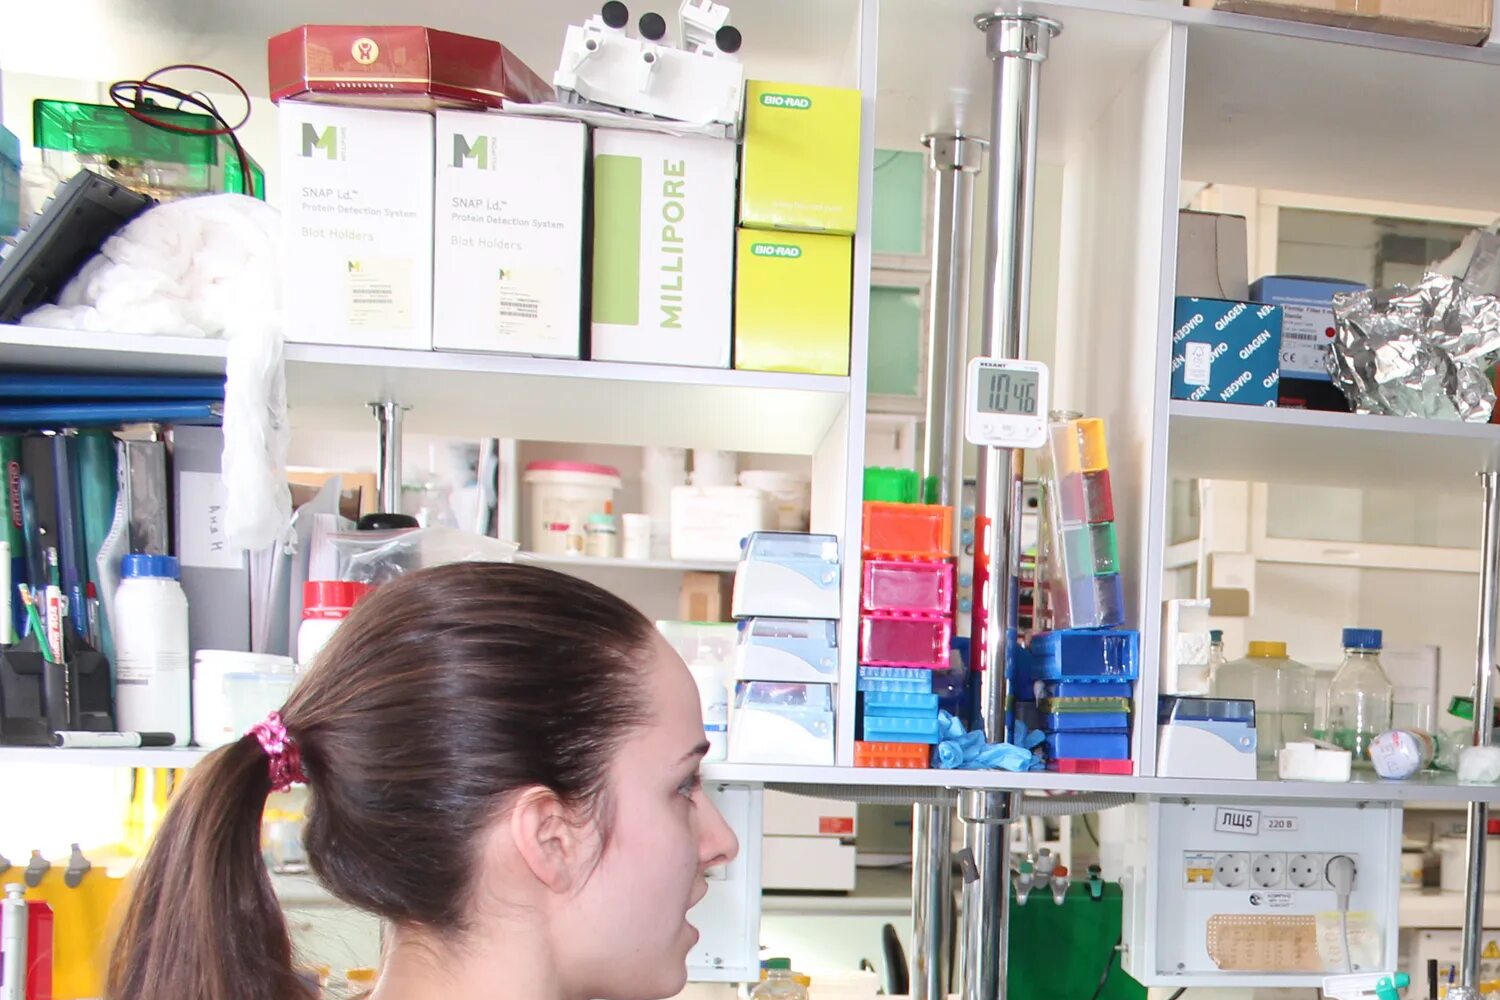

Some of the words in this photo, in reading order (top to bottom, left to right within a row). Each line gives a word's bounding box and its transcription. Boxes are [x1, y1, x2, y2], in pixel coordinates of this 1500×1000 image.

[302, 122, 338, 160] M
[452, 132, 488, 170] M
[302, 186, 334, 199] SNAP
[302, 202, 334, 212] Protein
[338, 204, 382, 216] Detection
[384, 208, 417, 219] System
[452, 196, 482, 209] SNAP
[451, 212, 484, 224] Protein
[486, 215, 530, 227] Detection
[532, 219, 564, 230] System
[302, 226, 325, 238] Blot
[329, 228, 375, 242] Holders
[450, 235, 474, 248] Blot
[478, 237, 523, 251] Holders
[660, 158, 686, 329] MILLIPORE
[1214, 302, 1248, 331] QIAGEN
[1172, 313, 1204, 344] QIAGEN
[1239, 329, 1272, 360] QIAGEN
[1220, 370, 1252, 401] QIAGEN
[1222, 812, 1253, 830] ЛЩ5
[1268, 820, 1284, 828] 220
